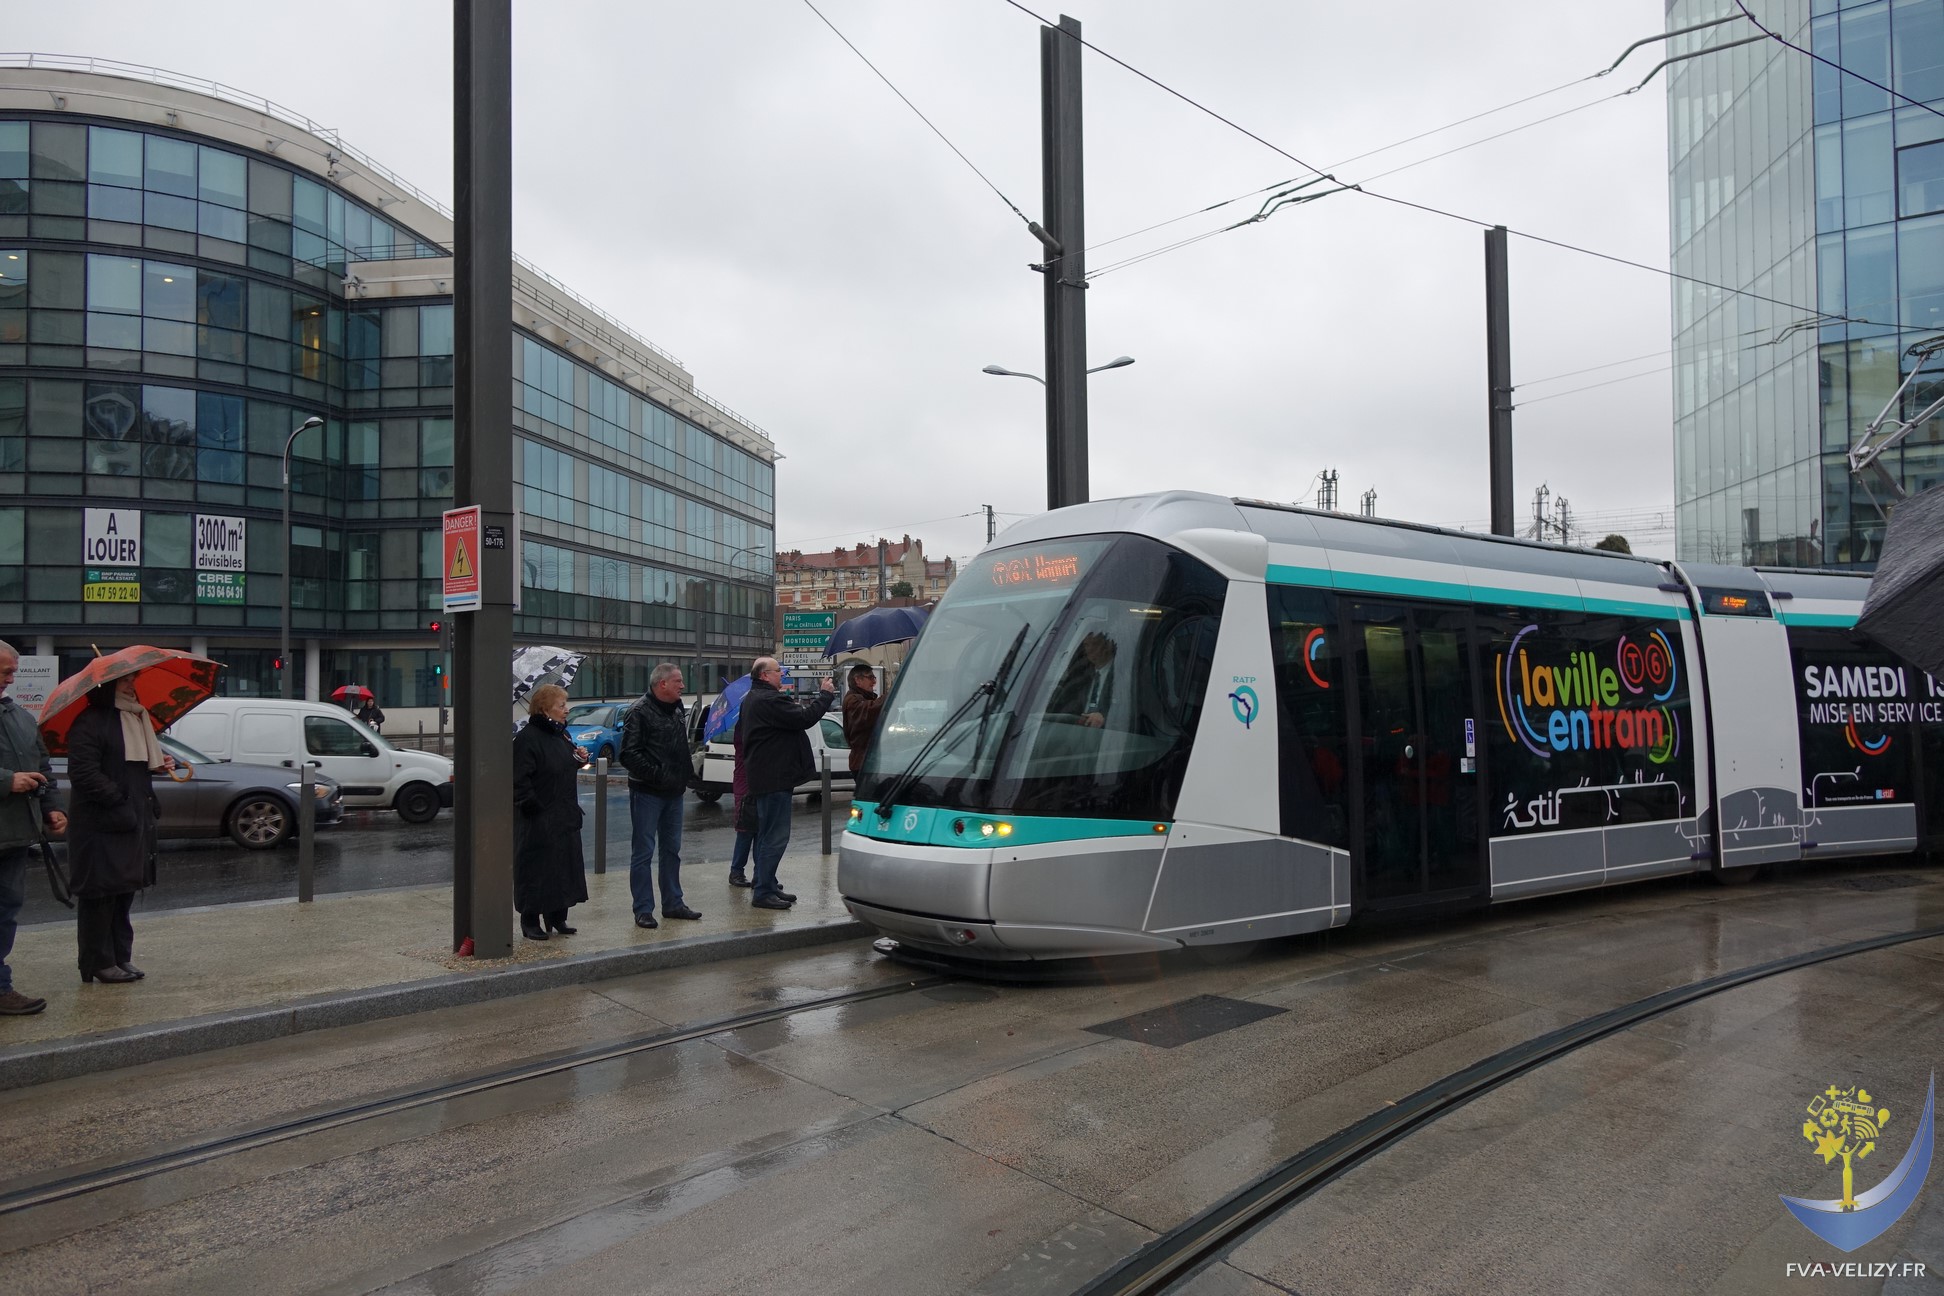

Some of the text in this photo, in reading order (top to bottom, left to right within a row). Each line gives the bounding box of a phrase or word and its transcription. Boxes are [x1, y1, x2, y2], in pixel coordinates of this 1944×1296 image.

[107, 512, 118, 535] A
[199, 518, 226, 551] 3000
[88, 538, 136, 561] LOUER
[199, 554, 242, 568] divisibles
[197, 573, 233, 584] CBRE
[86, 586, 139, 600] 01 47 59 22 40
[197, 585, 243, 599] 01 53 64 64 31
[1232, 675, 1257, 684] RATP
[1804, 665, 1907, 698] SAMEDI
[1810, 702, 1849, 724] MISE
[1852, 702, 1874, 723] EN
